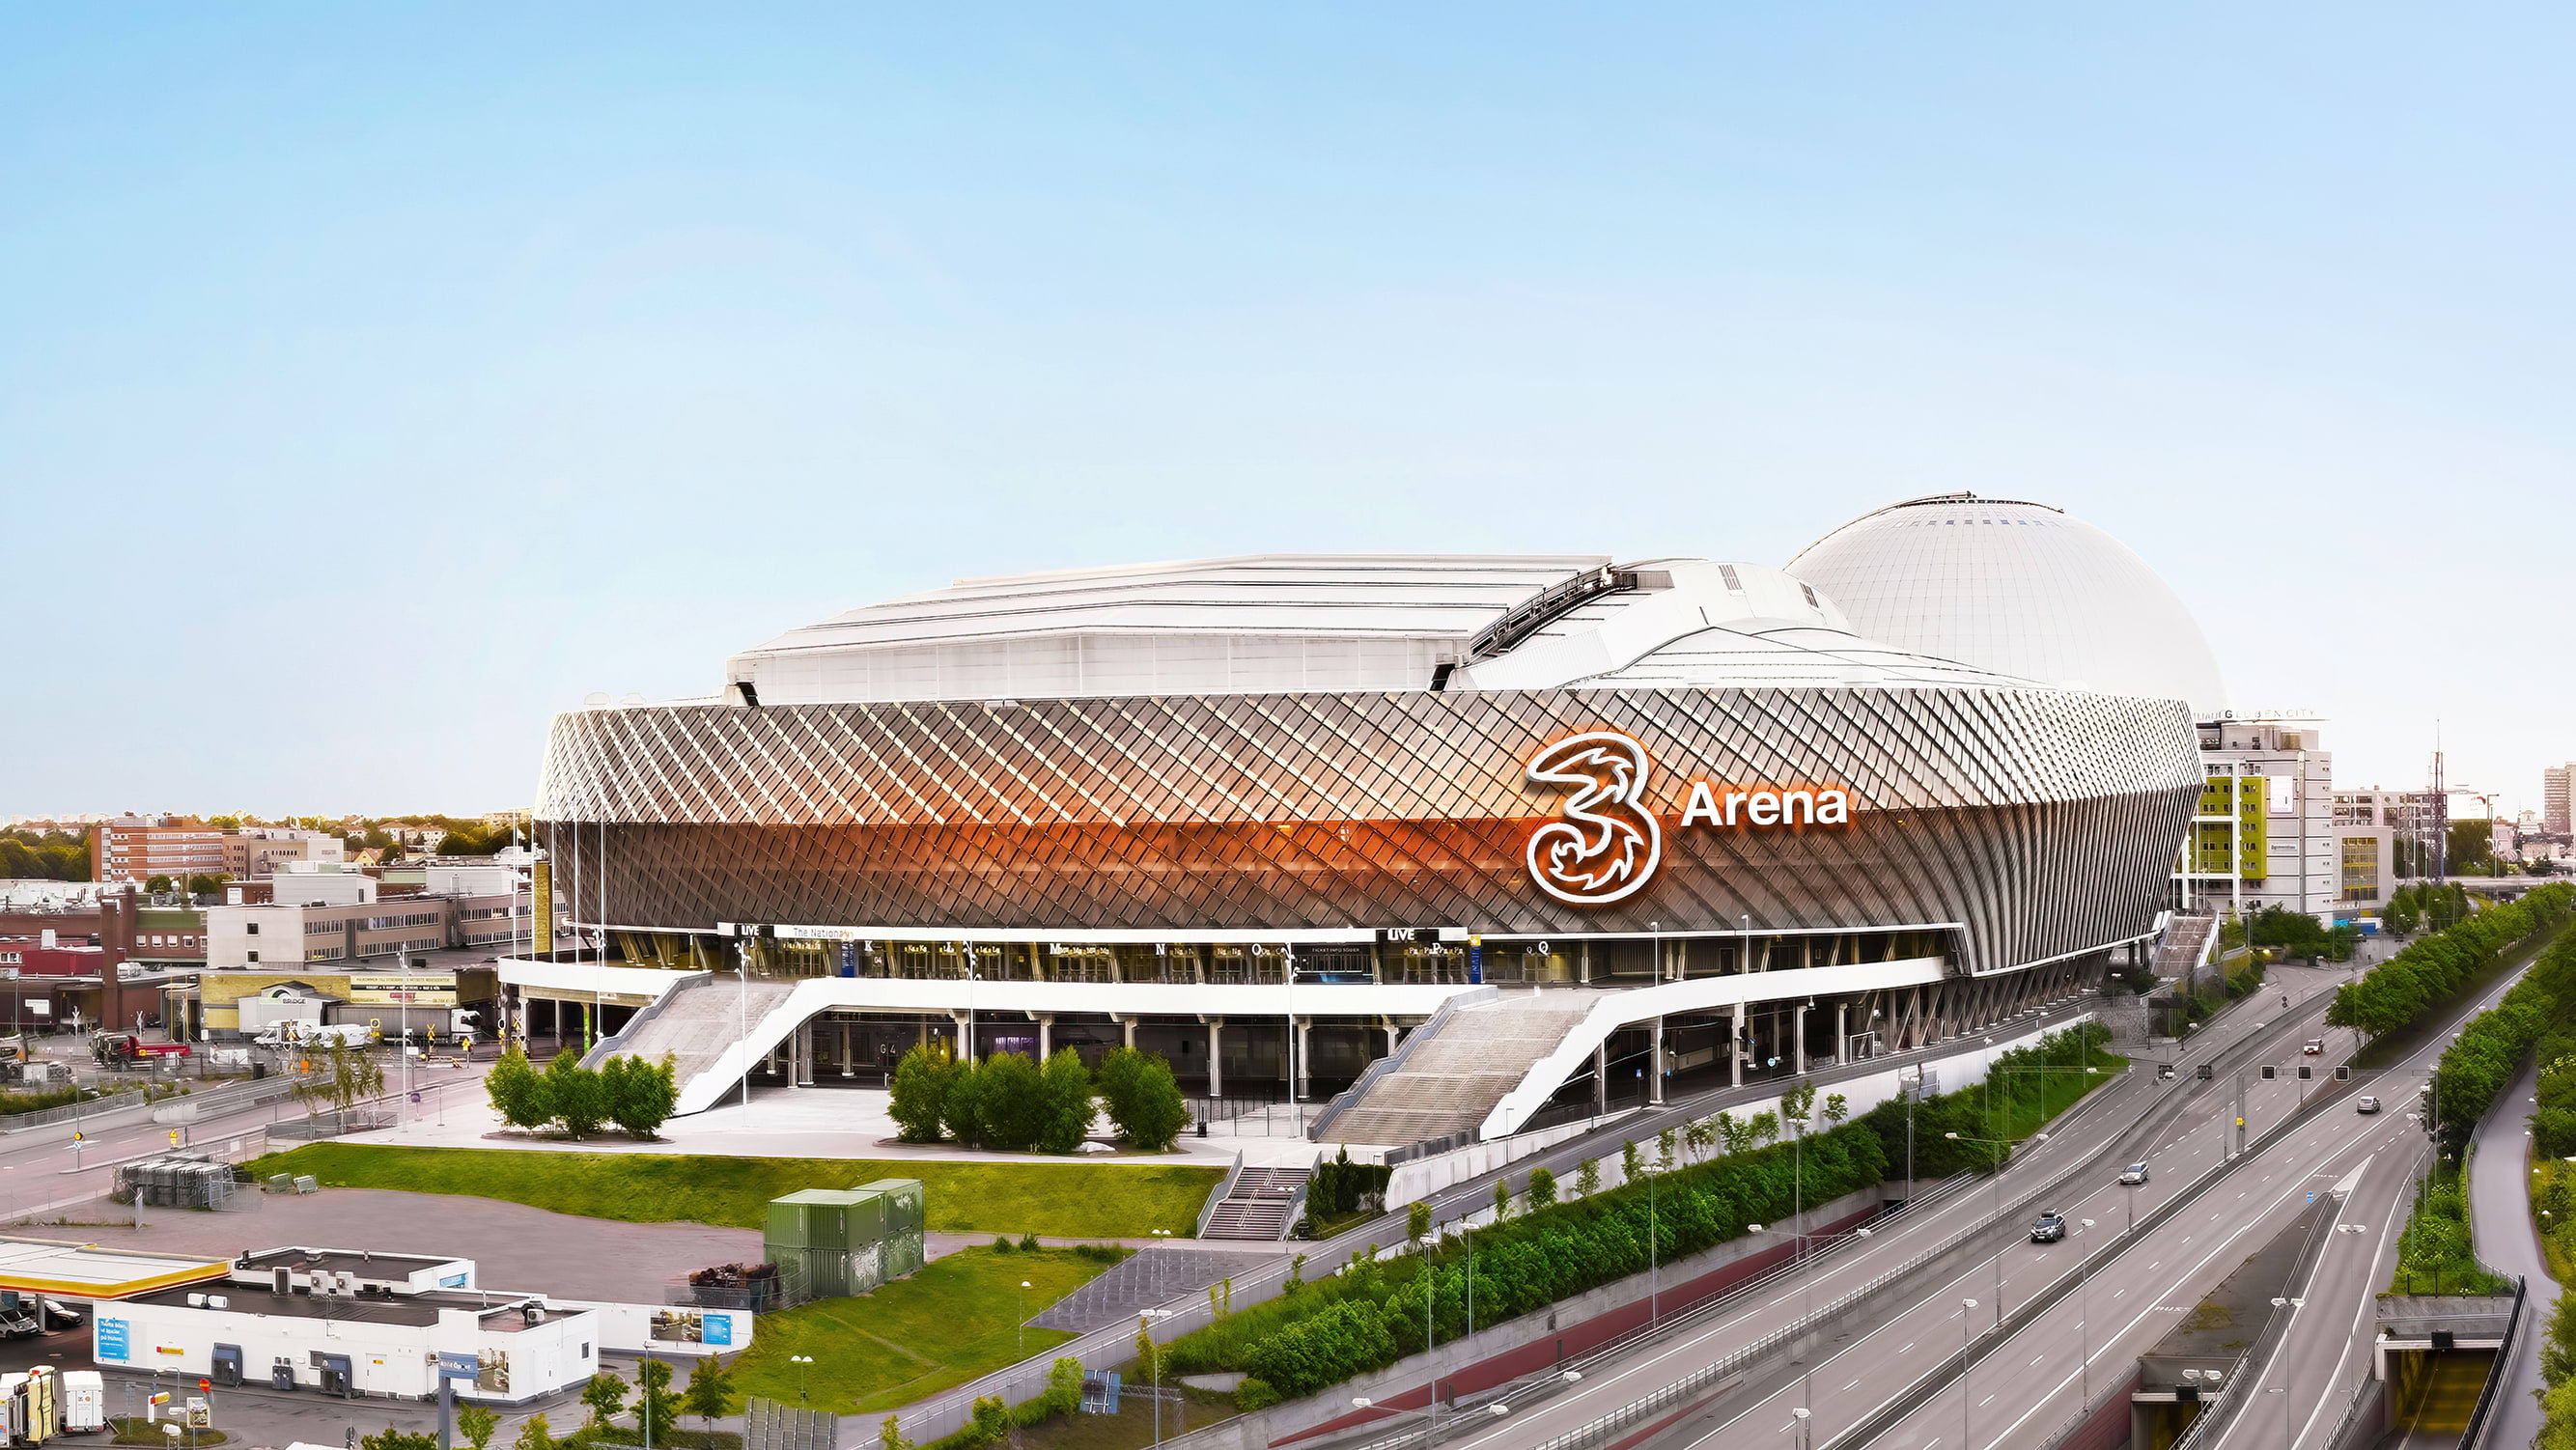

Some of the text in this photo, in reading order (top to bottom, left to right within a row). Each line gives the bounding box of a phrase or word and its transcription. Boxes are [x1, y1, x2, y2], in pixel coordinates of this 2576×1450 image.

[2286, 709, 2314, 717] CITY
[1680, 781, 1848, 827] Arena
[742, 925, 760, 936] LIVE
[793, 928, 808, 937] The
[1387, 929, 1415, 941] LIVE
[864, 940, 873, 952] K
[1155, 943, 1166, 956] N
[1251, 943, 1262, 956] O
[1432, 942, 1442, 955] P
[1538, 940, 1550, 957] Q
